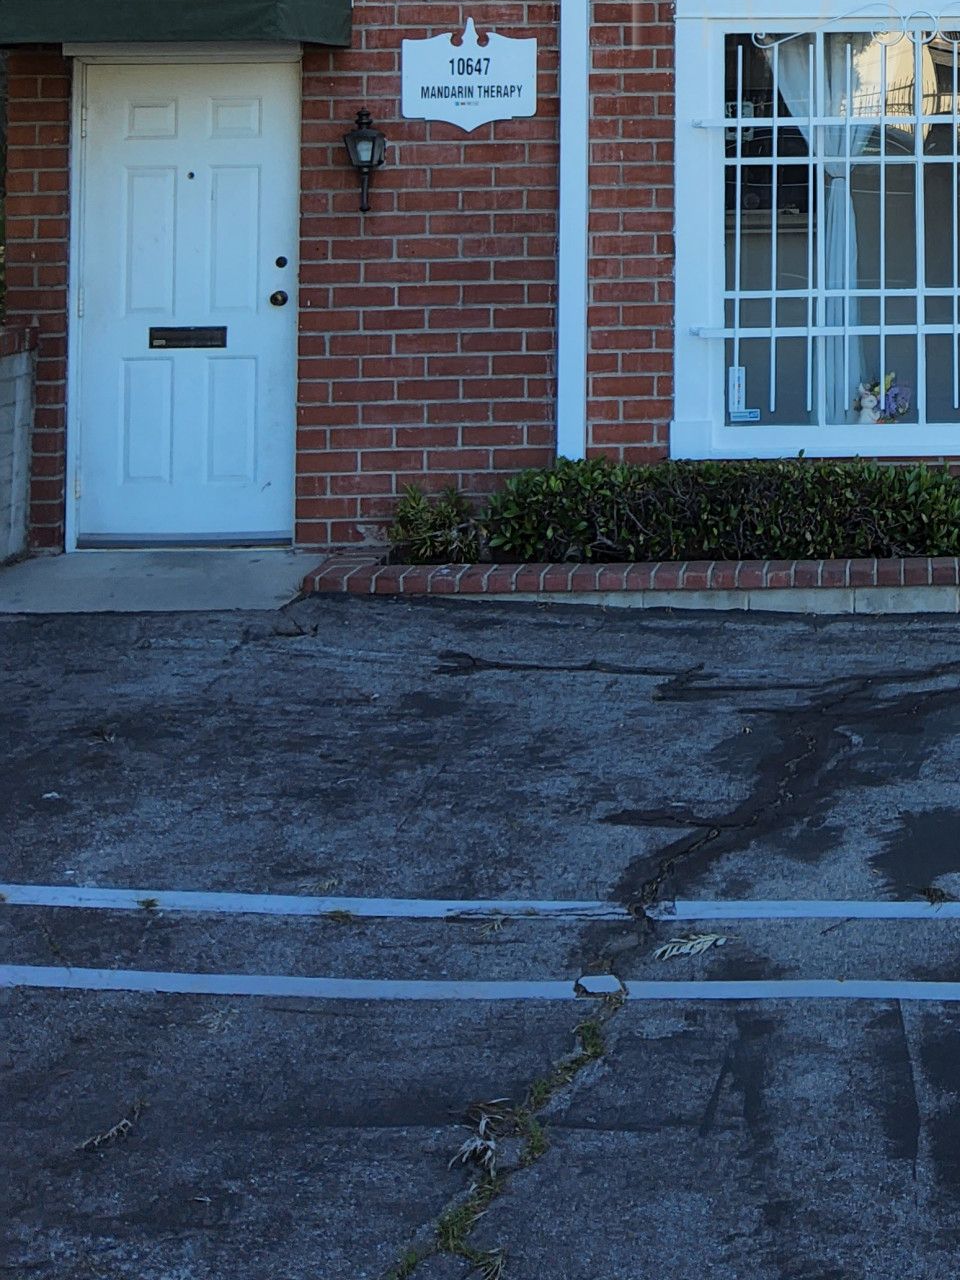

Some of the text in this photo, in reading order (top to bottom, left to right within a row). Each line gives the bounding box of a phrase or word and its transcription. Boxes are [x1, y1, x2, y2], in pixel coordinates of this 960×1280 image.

[448, 57, 491, 76] 10647
[420, 84, 523, 99] MANDARIN THERAPY
